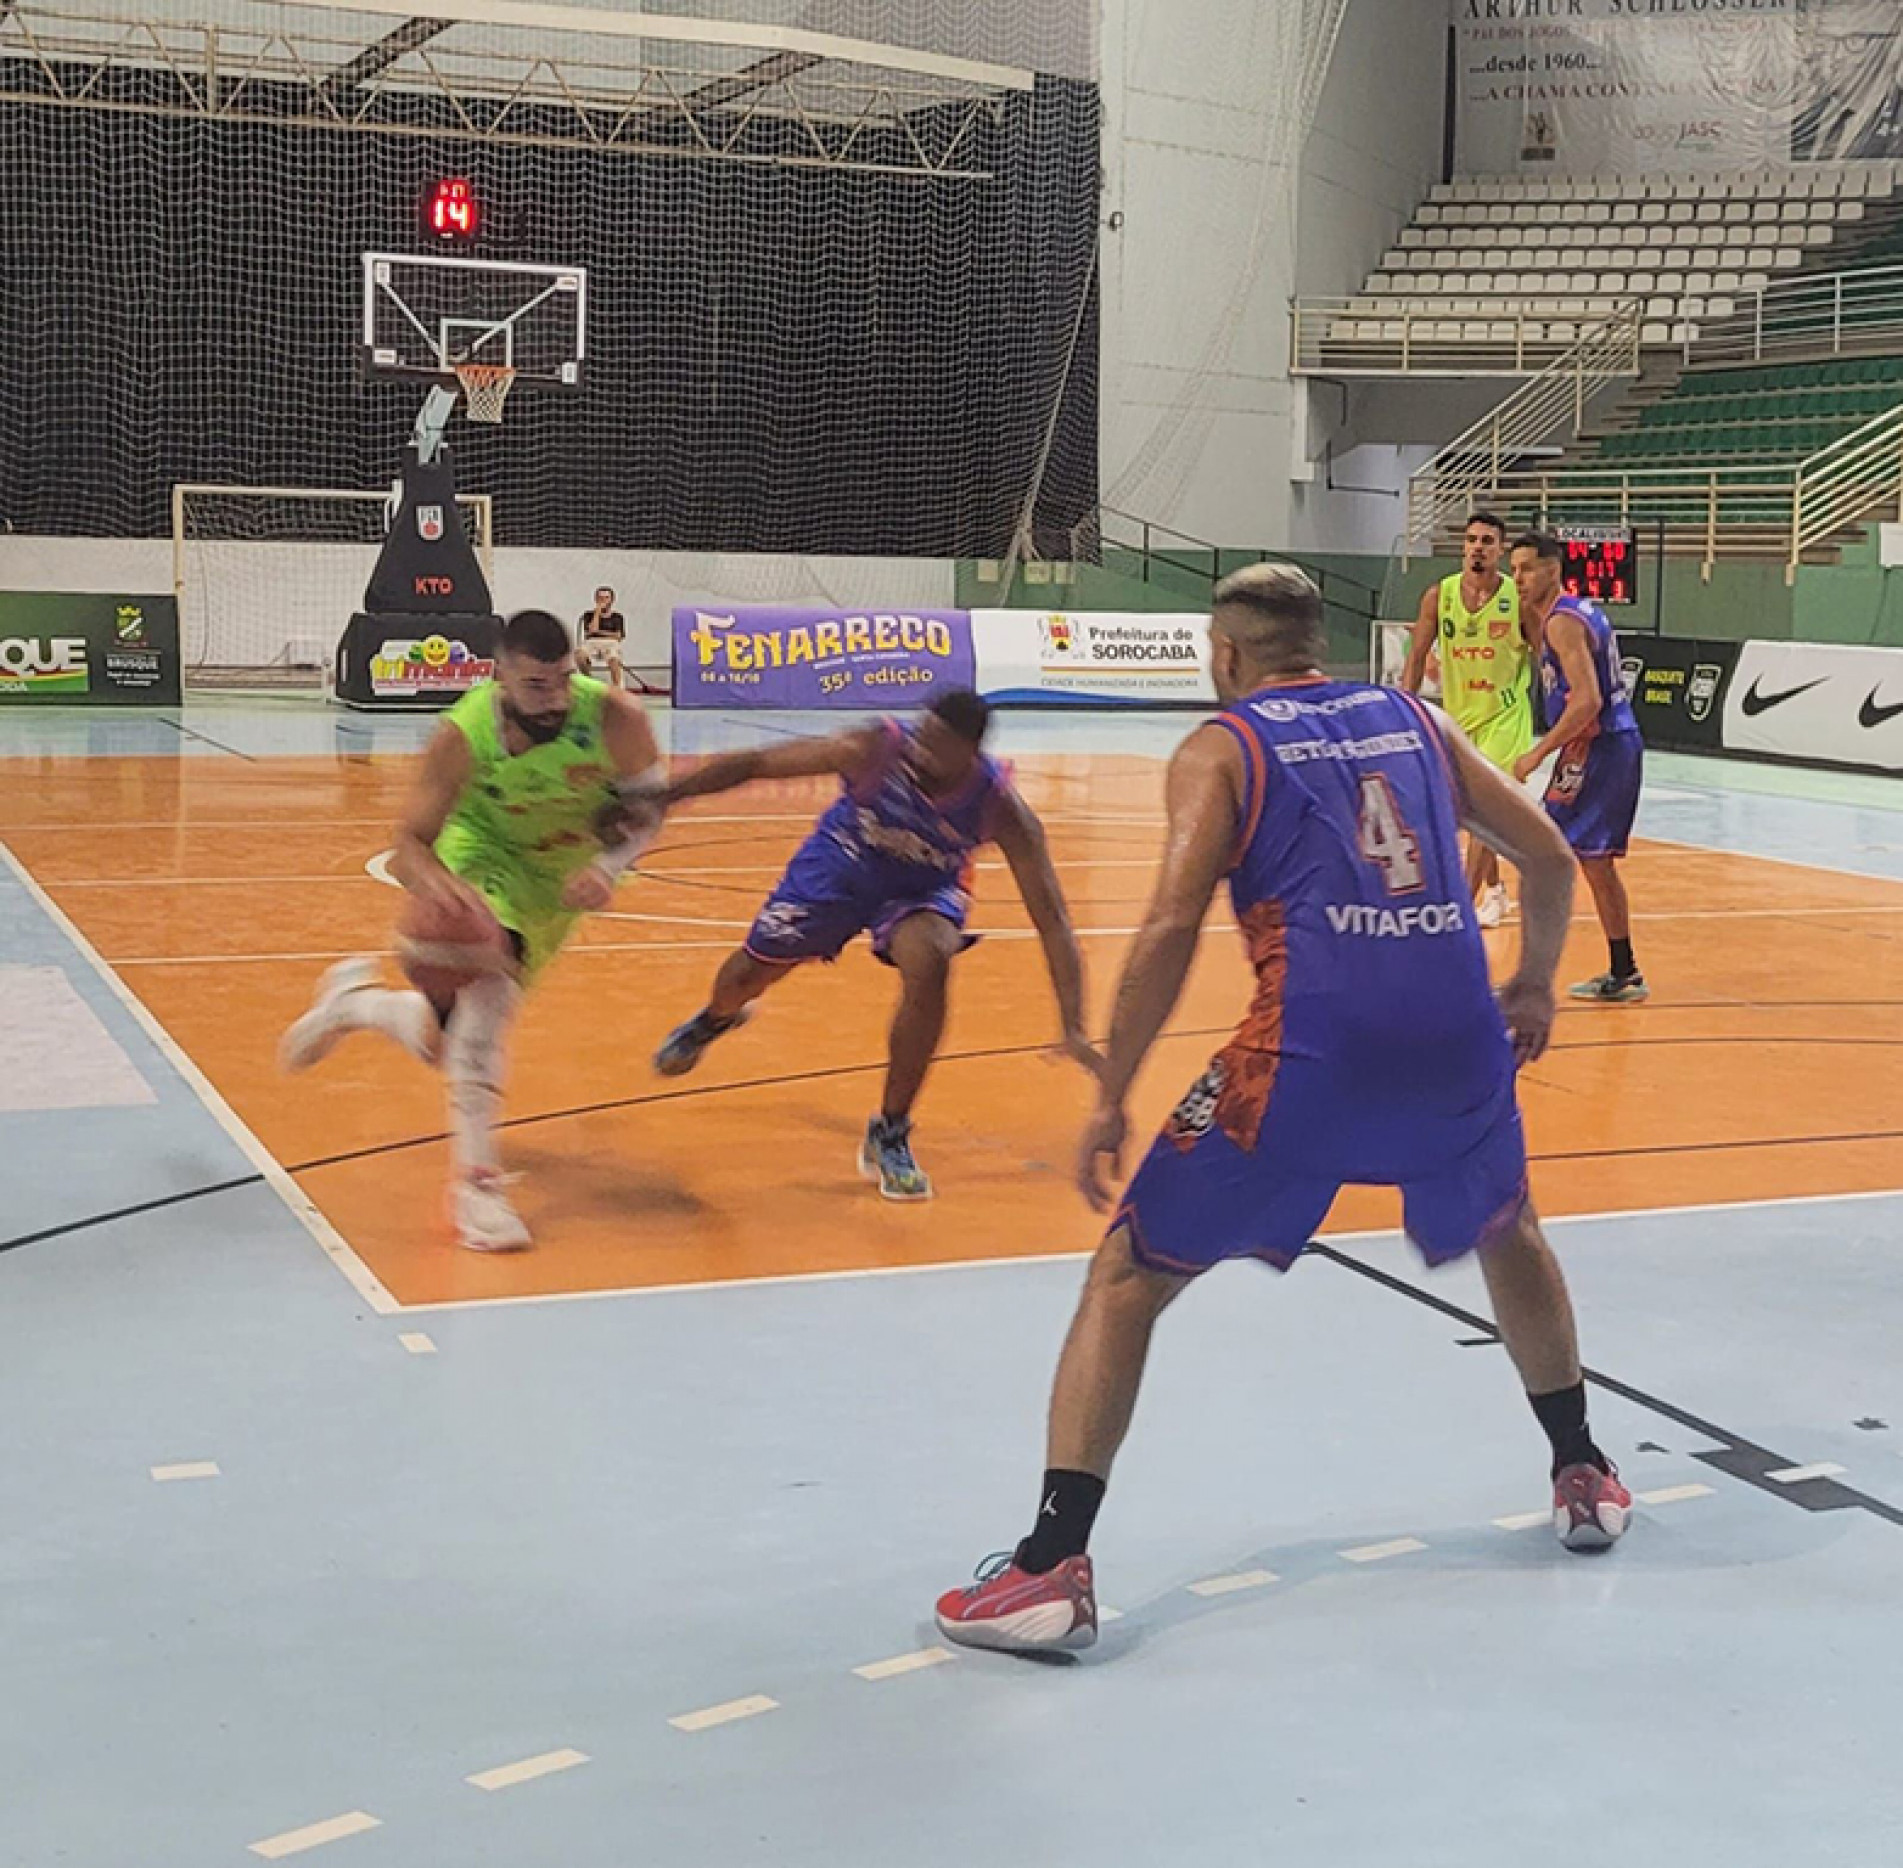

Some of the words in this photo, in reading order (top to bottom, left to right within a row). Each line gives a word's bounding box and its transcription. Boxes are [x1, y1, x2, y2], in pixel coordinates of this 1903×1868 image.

[1465, 0, 1583, 18] ARTHUR
[1503, 84, 1581, 99] CHAMA
[434, 198, 469, 231] 14
[415, 578, 453, 595] KTO
[690, 611, 952, 671] FENARRECO
[1089, 626, 1169, 641] Prefeitura
[1172, 627, 1194, 641] de
[1091, 643, 1199, 660] SOROCABA
[1452, 646, 1495, 661] KTO
[863, 664, 934, 686] edição
[1357, 771, 1426, 897] 4
[1325, 901, 1465, 938] VITAFOR
